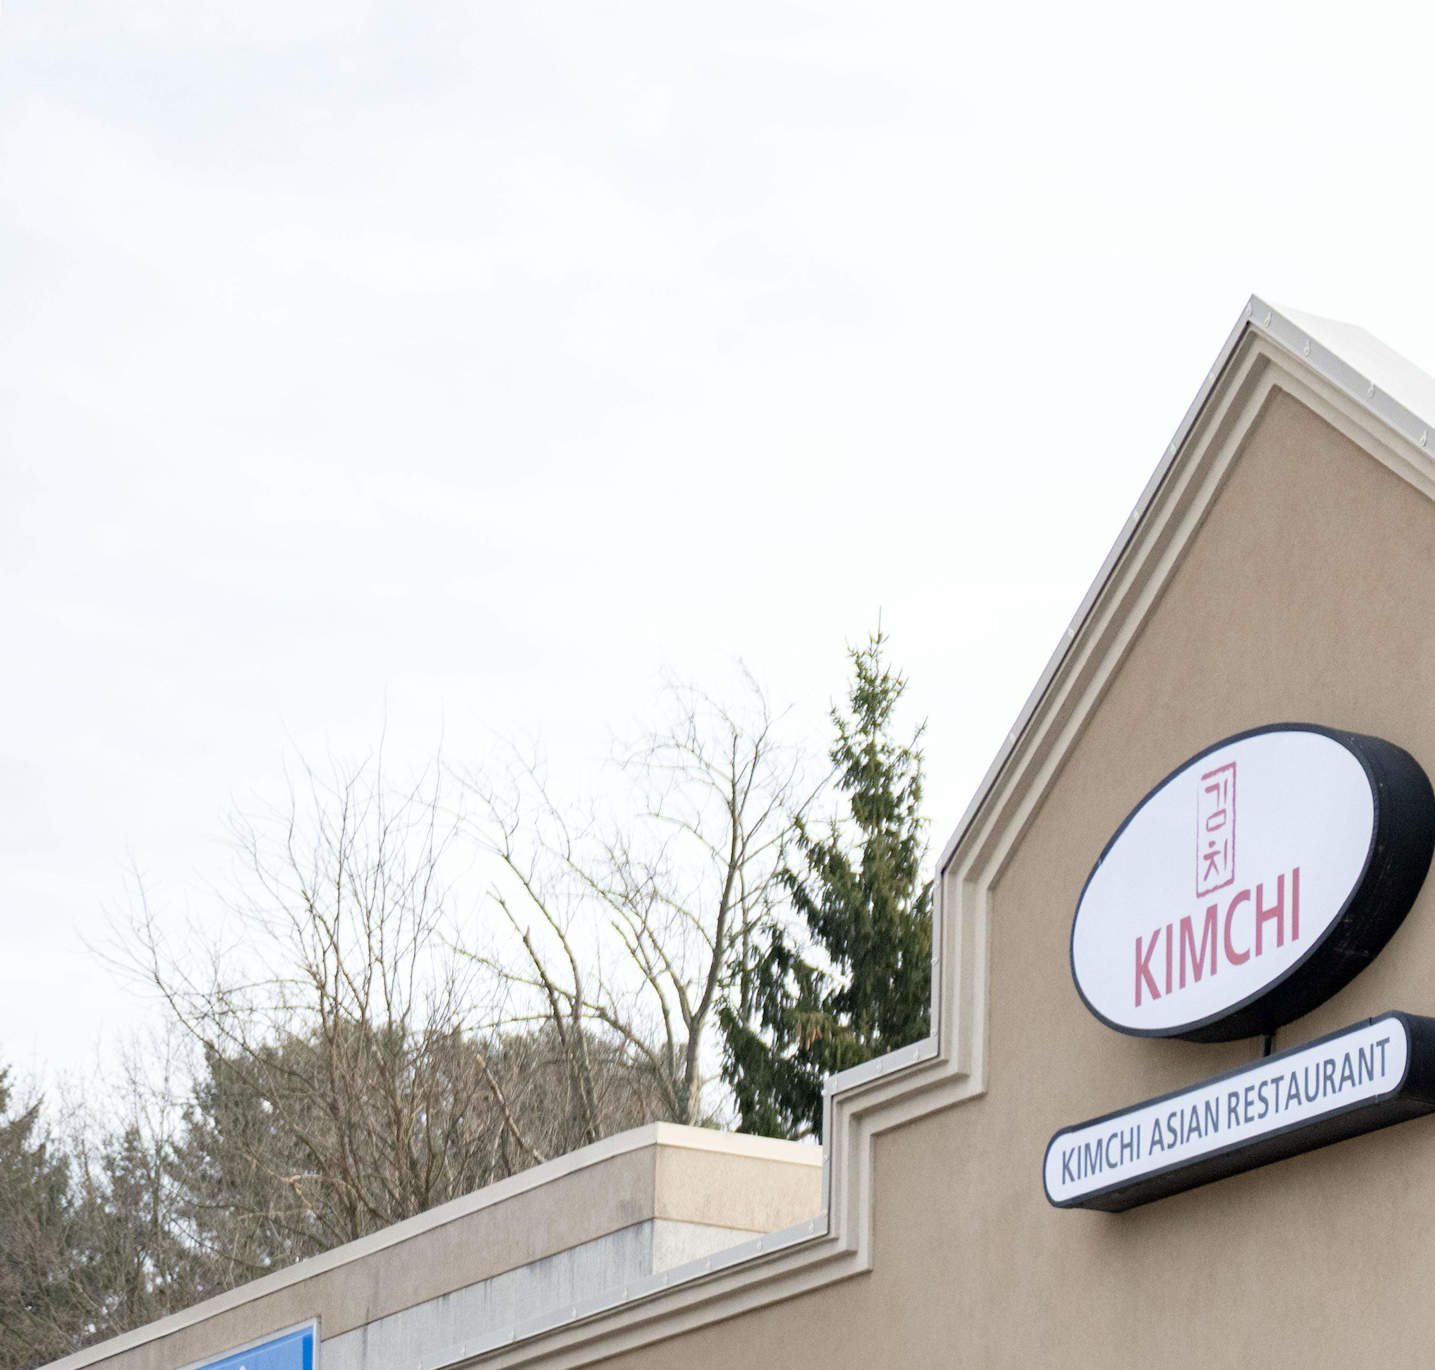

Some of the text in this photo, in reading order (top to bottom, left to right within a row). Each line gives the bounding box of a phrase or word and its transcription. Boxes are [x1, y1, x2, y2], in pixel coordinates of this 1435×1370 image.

[1203, 777, 1229, 882] 김치
[1135, 867, 1300, 1008] KIMCHI
[1062, 1037, 1390, 1185] KIMCHI ASIAN RESTAURANT
